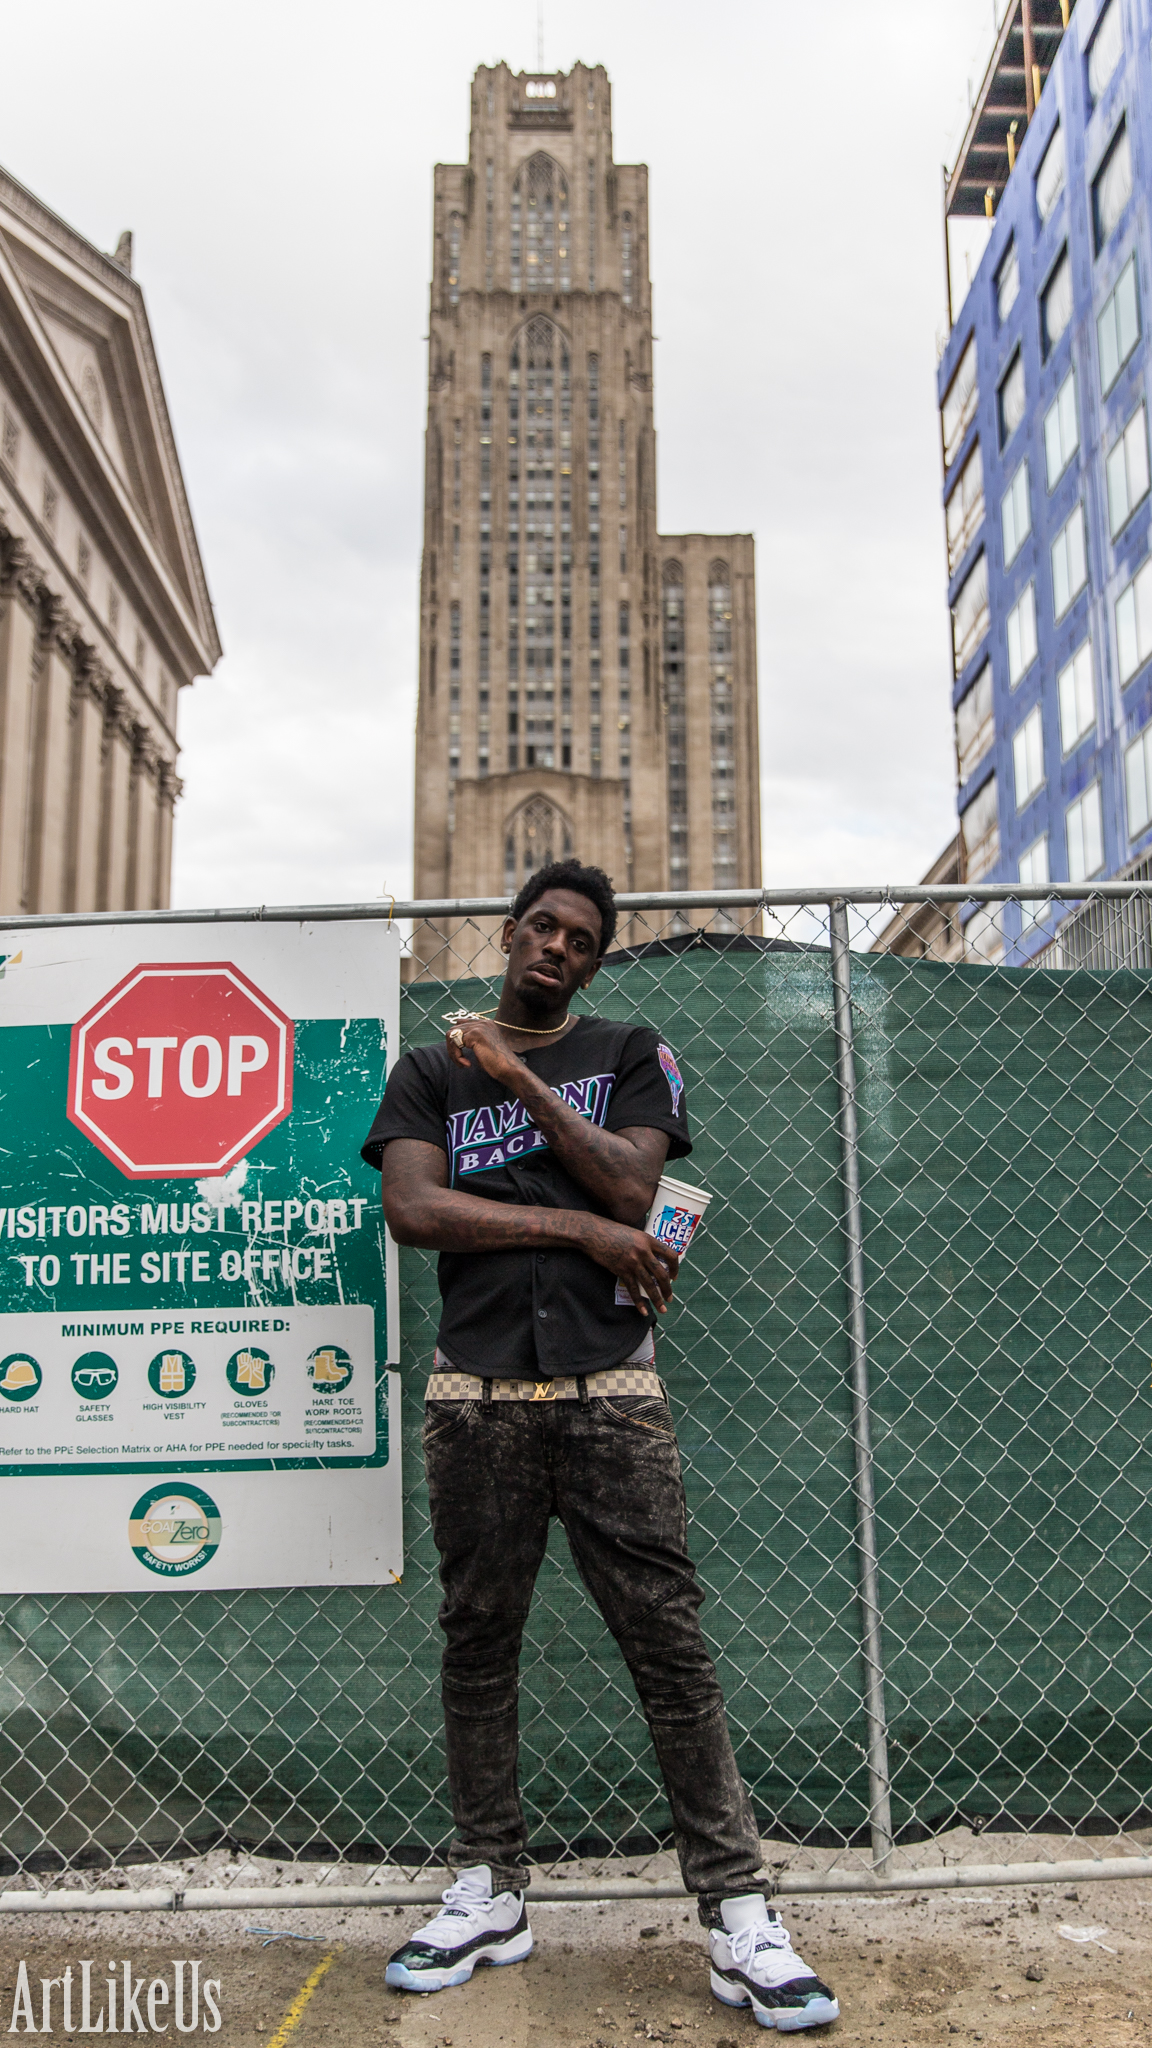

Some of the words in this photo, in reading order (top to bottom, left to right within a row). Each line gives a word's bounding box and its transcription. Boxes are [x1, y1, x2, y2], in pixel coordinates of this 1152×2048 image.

[91, 1035, 269, 1100] STOP
[141, 1202, 232, 1235] MUST
[242, 1199, 368, 1232] REPORT
[672, 1210, 693, 1226] 25
[660, 1220, 693, 1242] ICEE
[20, 1255, 60, 1287] TO
[70, 1253, 130, 1285] THE
[141, 1251, 210, 1283] SITE
[221, 1249, 332, 1282] OFFICE
[62, 1323, 144, 1336] MINIMUM
[151, 1322, 184, 1335] PPE
[191, 1320, 290, 1334] REQUIRED:
[165, 1402, 206, 1410] VISIBILITY
[25, 1447, 34, 1455] to
[37, 1446, 51, 1455] the
[54, 1446, 73, 1454] PPE
[76, 1445, 119, 1454] Selection
[122, 1445, 150, 1453] Matrix
[165, 1443, 186, 1452] AHA
[189, 1443, 201, 1452] for
[205, 1442, 225, 1451] PPE
[228, 1441, 264, 1451] needed
[267, 1441, 280, 1450] for
[327, 1439, 355, 1448] tasks.
[142, 1551, 173, 1572] SAFETY
[174, 1550, 207, 1572] WORKS!
